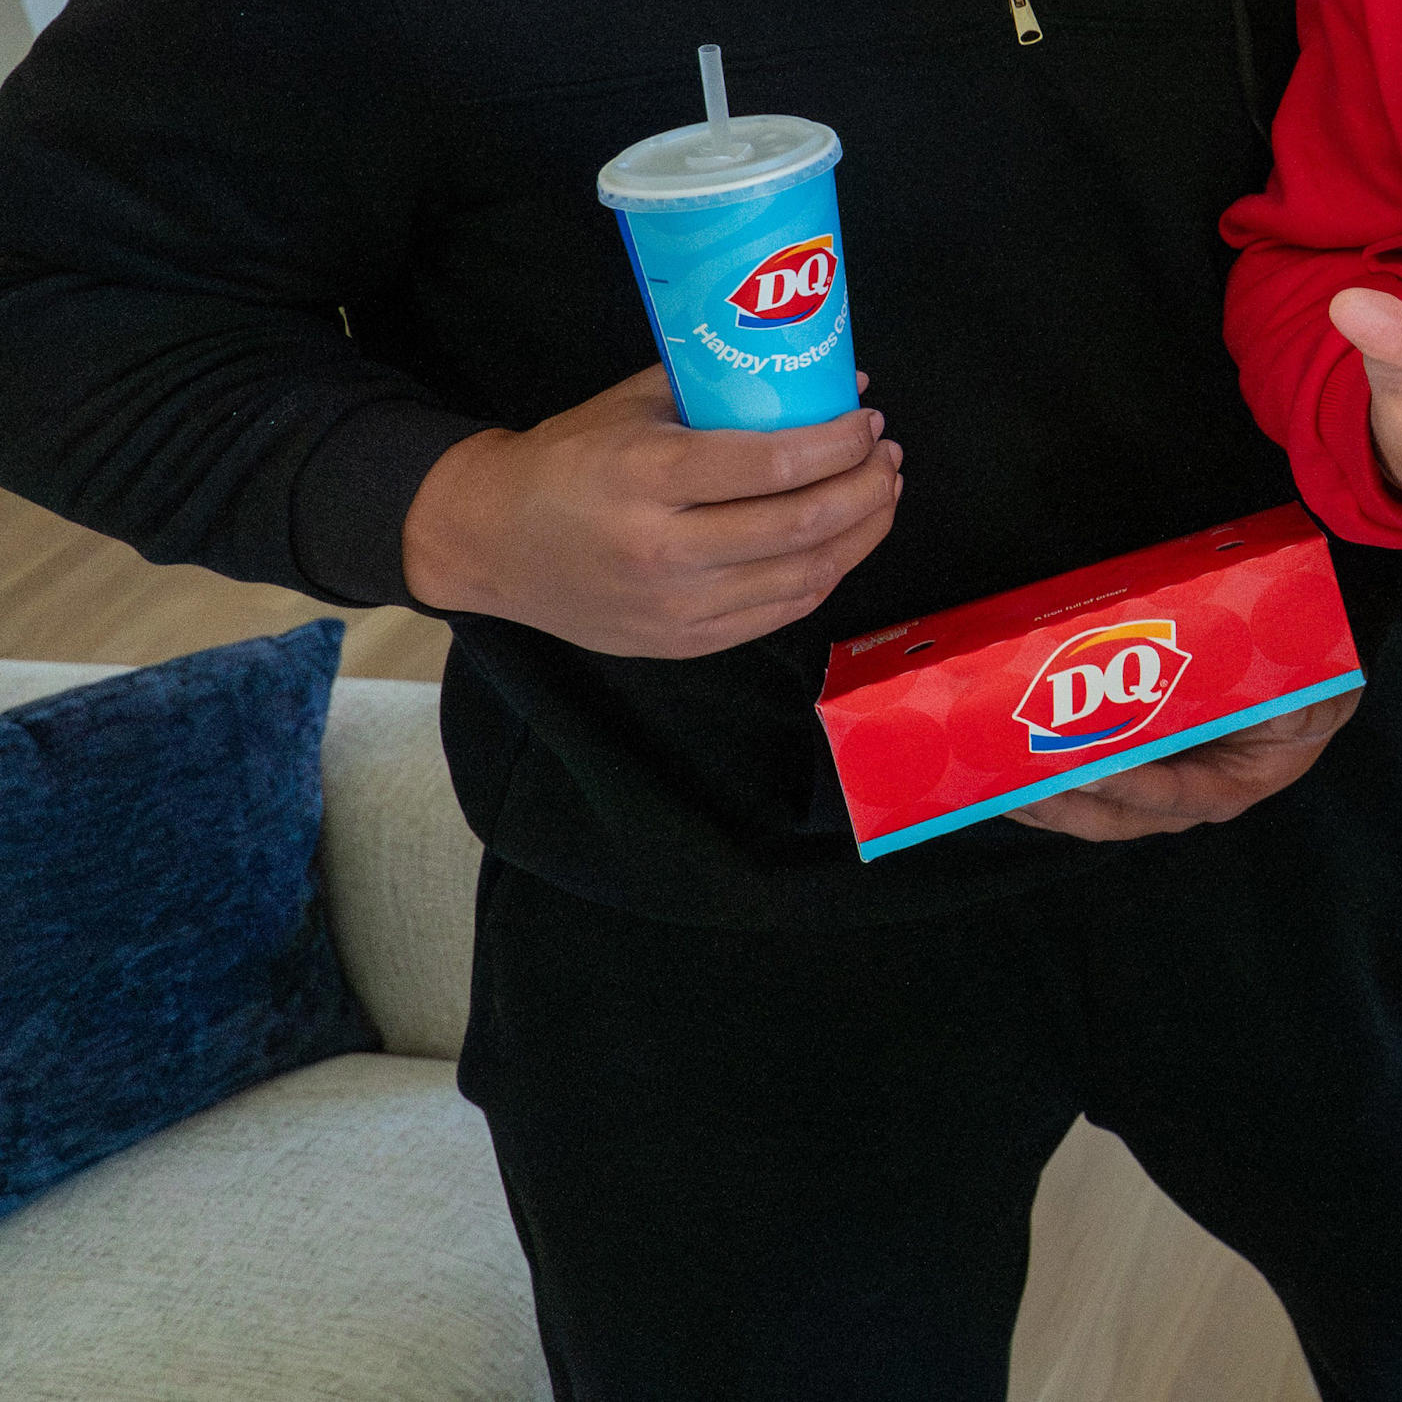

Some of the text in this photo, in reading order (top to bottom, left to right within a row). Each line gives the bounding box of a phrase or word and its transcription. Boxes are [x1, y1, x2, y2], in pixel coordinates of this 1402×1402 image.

[754, 252, 829, 313] DQ
[692, 323, 770, 375] Happy
[770, 331, 838, 373] Tastes
[1046, 644, 1164, 729] DQ
